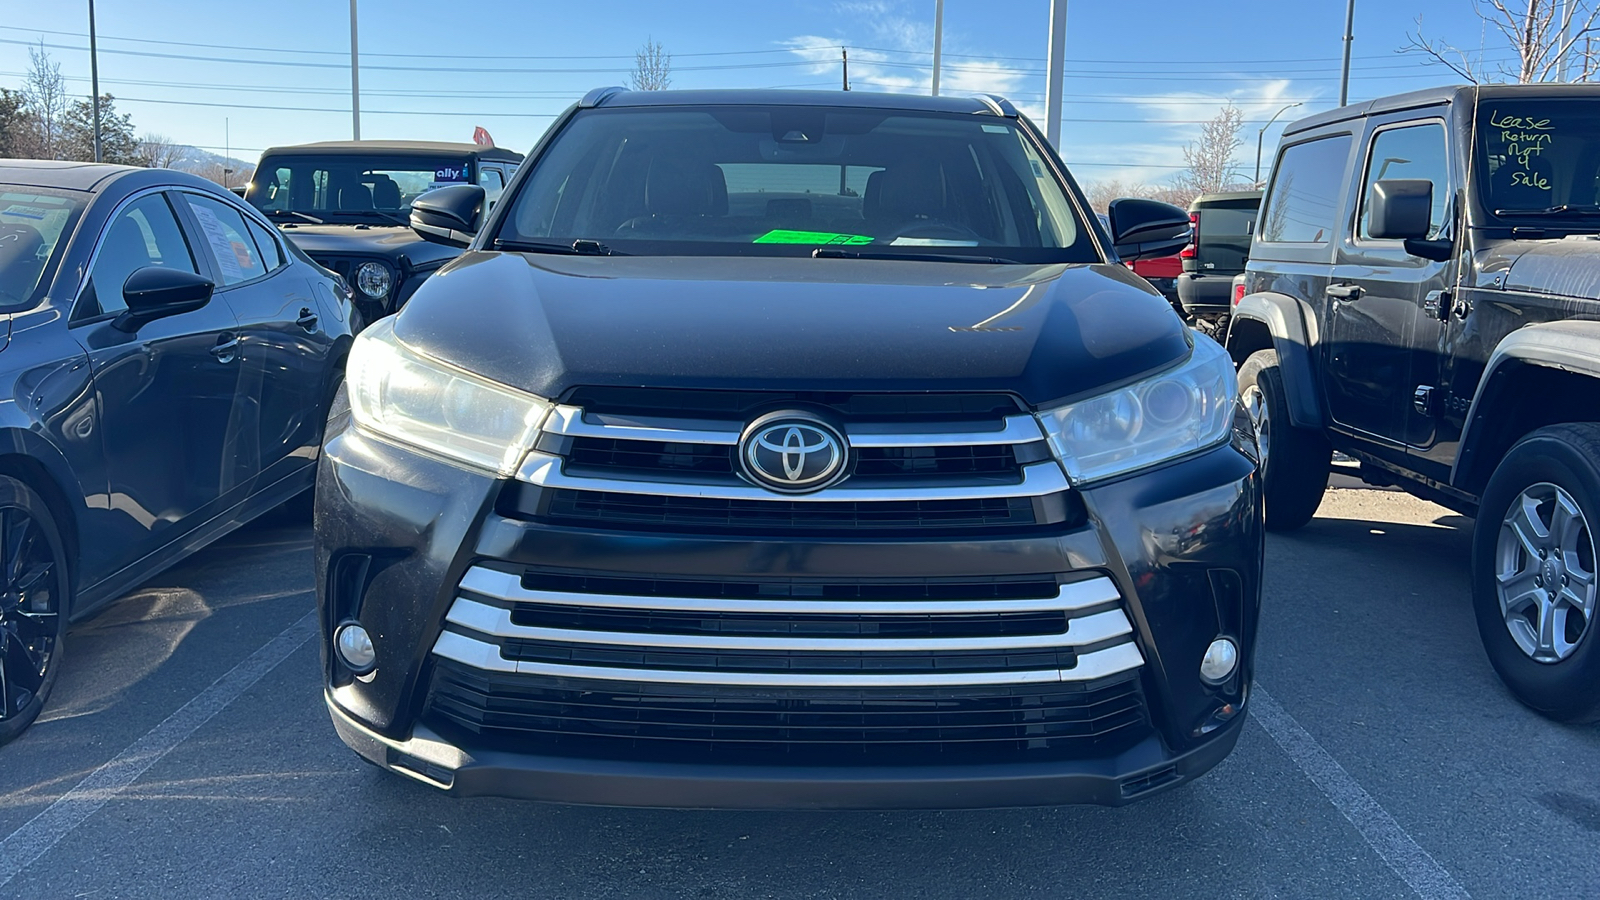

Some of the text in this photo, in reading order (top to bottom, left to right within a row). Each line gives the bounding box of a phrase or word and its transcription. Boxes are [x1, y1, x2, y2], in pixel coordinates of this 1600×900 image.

[1490, 109, 1556, 130] Lease
[1501, 130, 1552, 144] Return
[1517, 155, 1530, 171] 4
